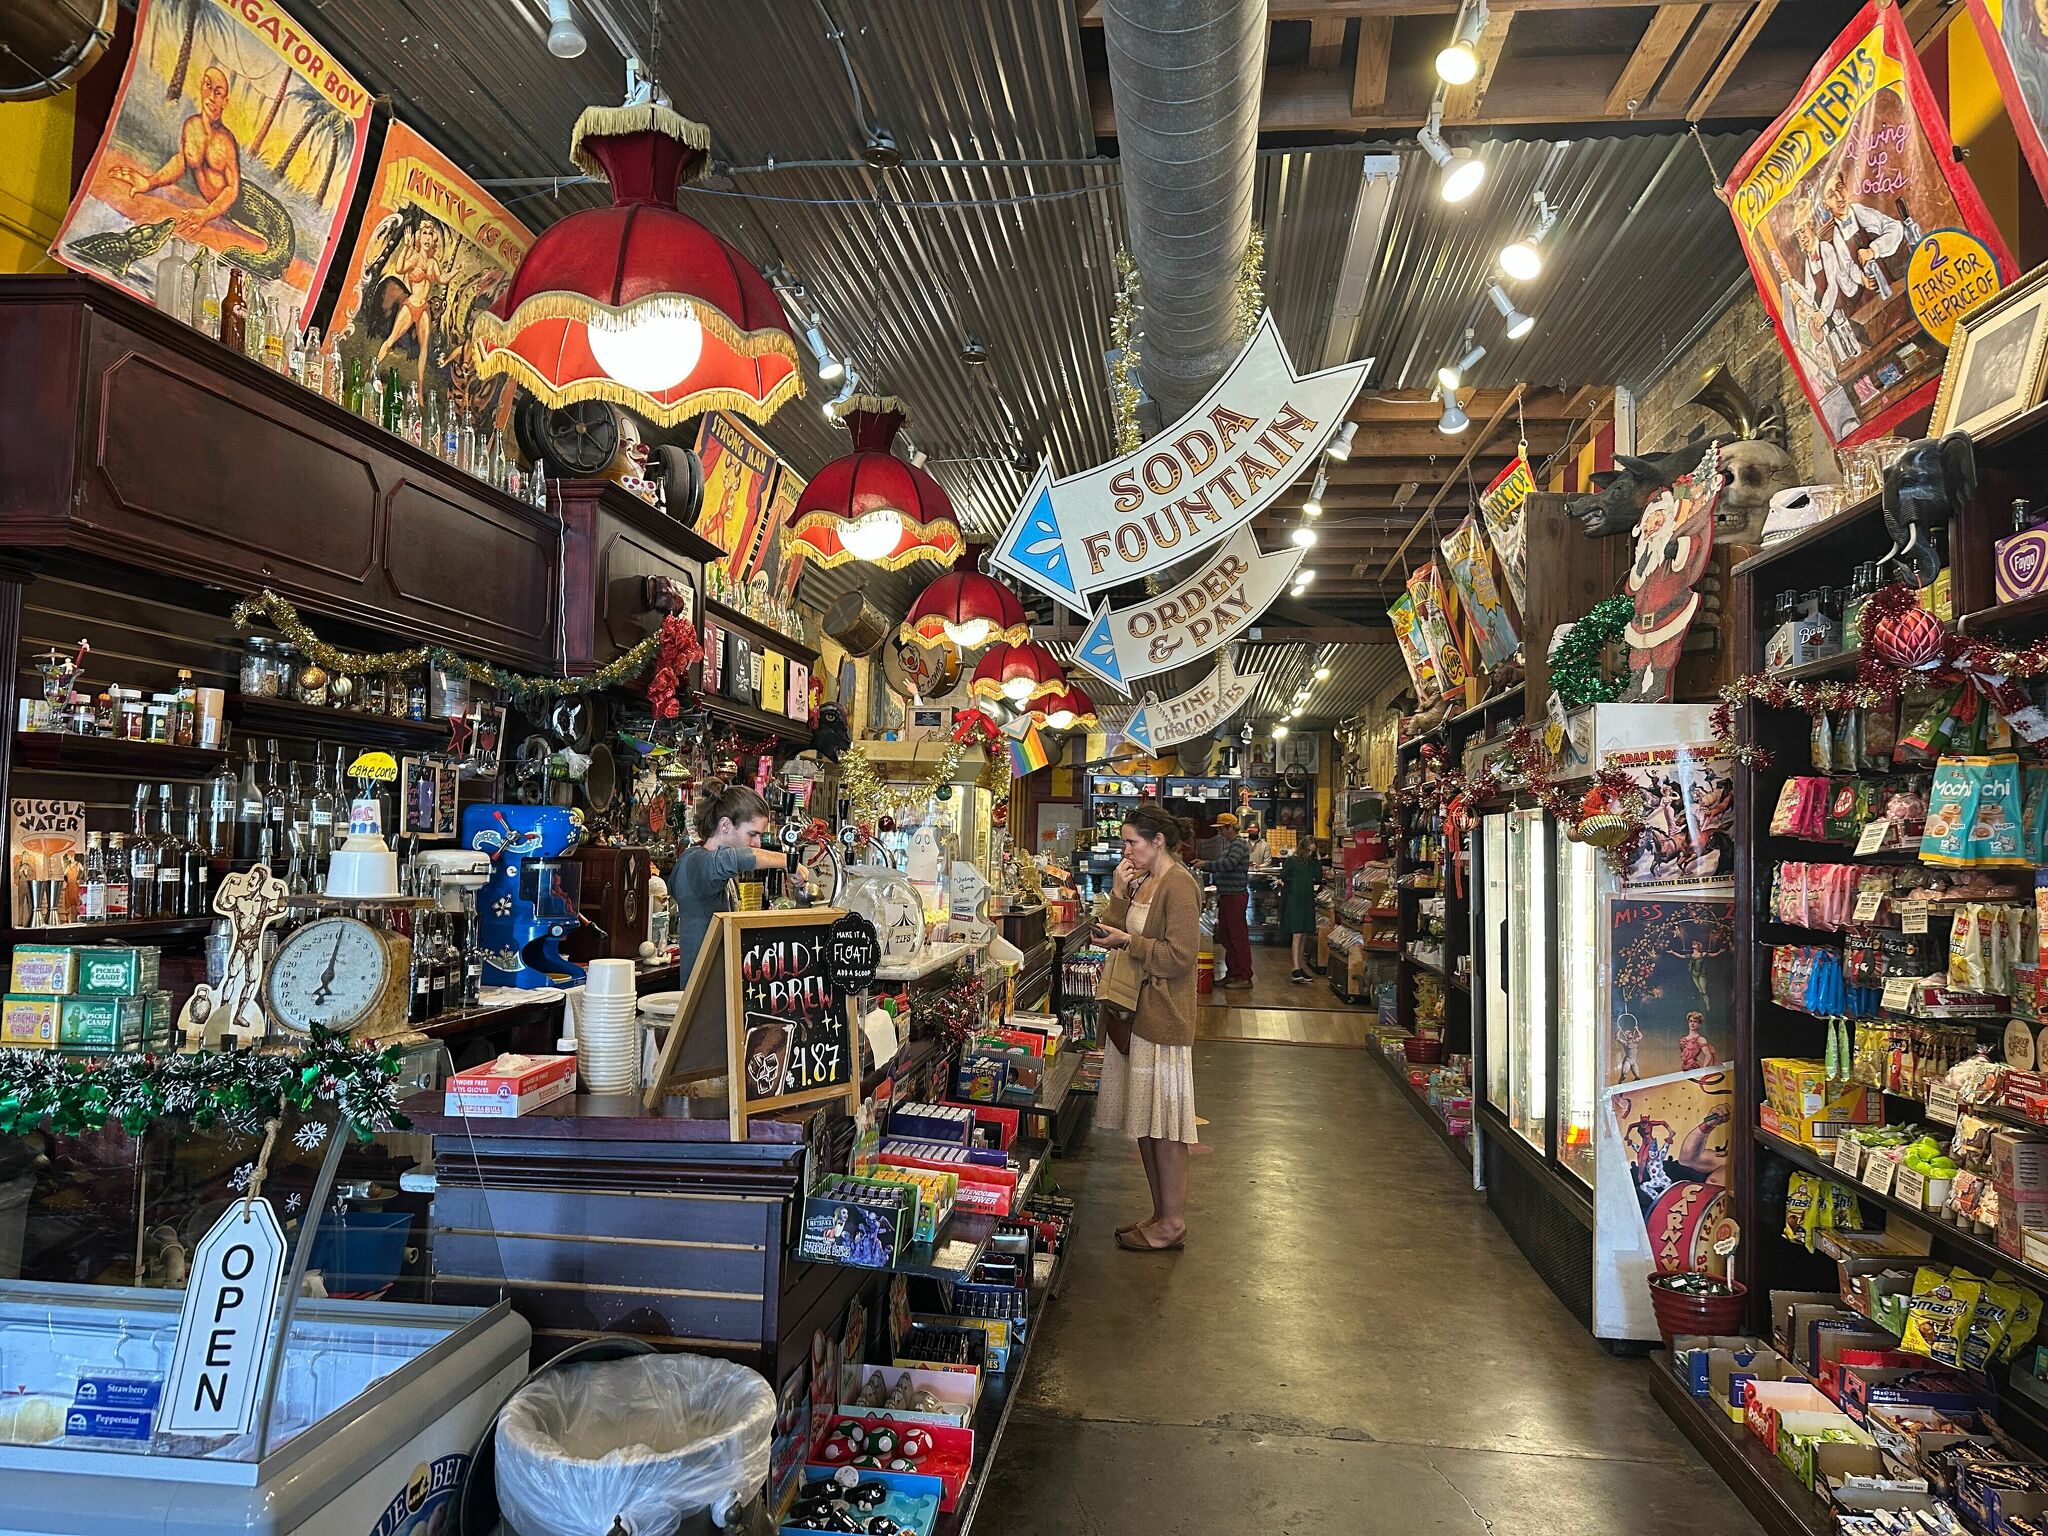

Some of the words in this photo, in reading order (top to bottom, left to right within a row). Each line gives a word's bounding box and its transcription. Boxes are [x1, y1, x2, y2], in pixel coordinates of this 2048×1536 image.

[324, 71, 364, 110] BOY
[1867, 152, 1888, 178] up
[408, 167, 477, 226] KITTY
[475, 222, 502, 249] IS
[1925, 239, 1949, 270] 2
[1912, 270, 1956, 306] JERKS
[1954, 253, 1985, 283] FOR
[1919, 306, 1947, 329] THE
[1941, 284, 1976, 318] PRICE
[1977, 270, 1995, 295] OF
[711, 415, 745, 454] STRONG
[746, 442, 768, 473] MAN
[1109, 403, 1259, 513] SODA
[1080, 401, 1319, 575] FOUNTAIN
[2014, 552, 2036, 572] Faygo
[1127, 554, 1249, 639] ORDER
[1148, 634, 1184, 663] &
[1185, 583, 1254, 648] PAY
[1799, 621, 1832, 645] Barq's
[1154, 682, 1246, 742] CHOCOLATES
[1169, 685, 1216, 720] FINE
[1619, 752, 1650, 764] ADAM
[1932, 780, 1974, 797] Mochi
[1982, 778, 2010, 796] chi
[13, 800, 86, 819] GIGGLE
[19, 814, 79, 833] WATER
[1677, 878, 1700, 886] RIDERS
[1614, 904, 1663, 928] MISS
[1724, 903, 1735, 920] Z
[836, 931, 853, 939] MAKE
[854, 930, 861, 938] IT
[861, 930, 867, 938] A
[895, 935, 911, 944] TIPS
[743, 941, 811, 983] COLD
[833, 943, 874, 965] FLOAT!
[854, 969, 871, 977] SCOOP
[769, 975, 834, 1017] BREW
[785, 1042, 840, 1088] $4.87
[956, 1188, 988, 1197] INTENDO
[967, 1196, 998, 1205] POWER
[1659, 1184, 1704, 1271] CARNAV
[1909, 1296, 1967, 1315] Smash!
[1975, 1304, 2008, 1320] sh!
[194, 1243, 254, 1412] OPEN
[107, 1383, 148, 1396] Strawberry
[95, 1413, 139, 1425] Peppermint
[376, 1494, 405, 1536] UE
